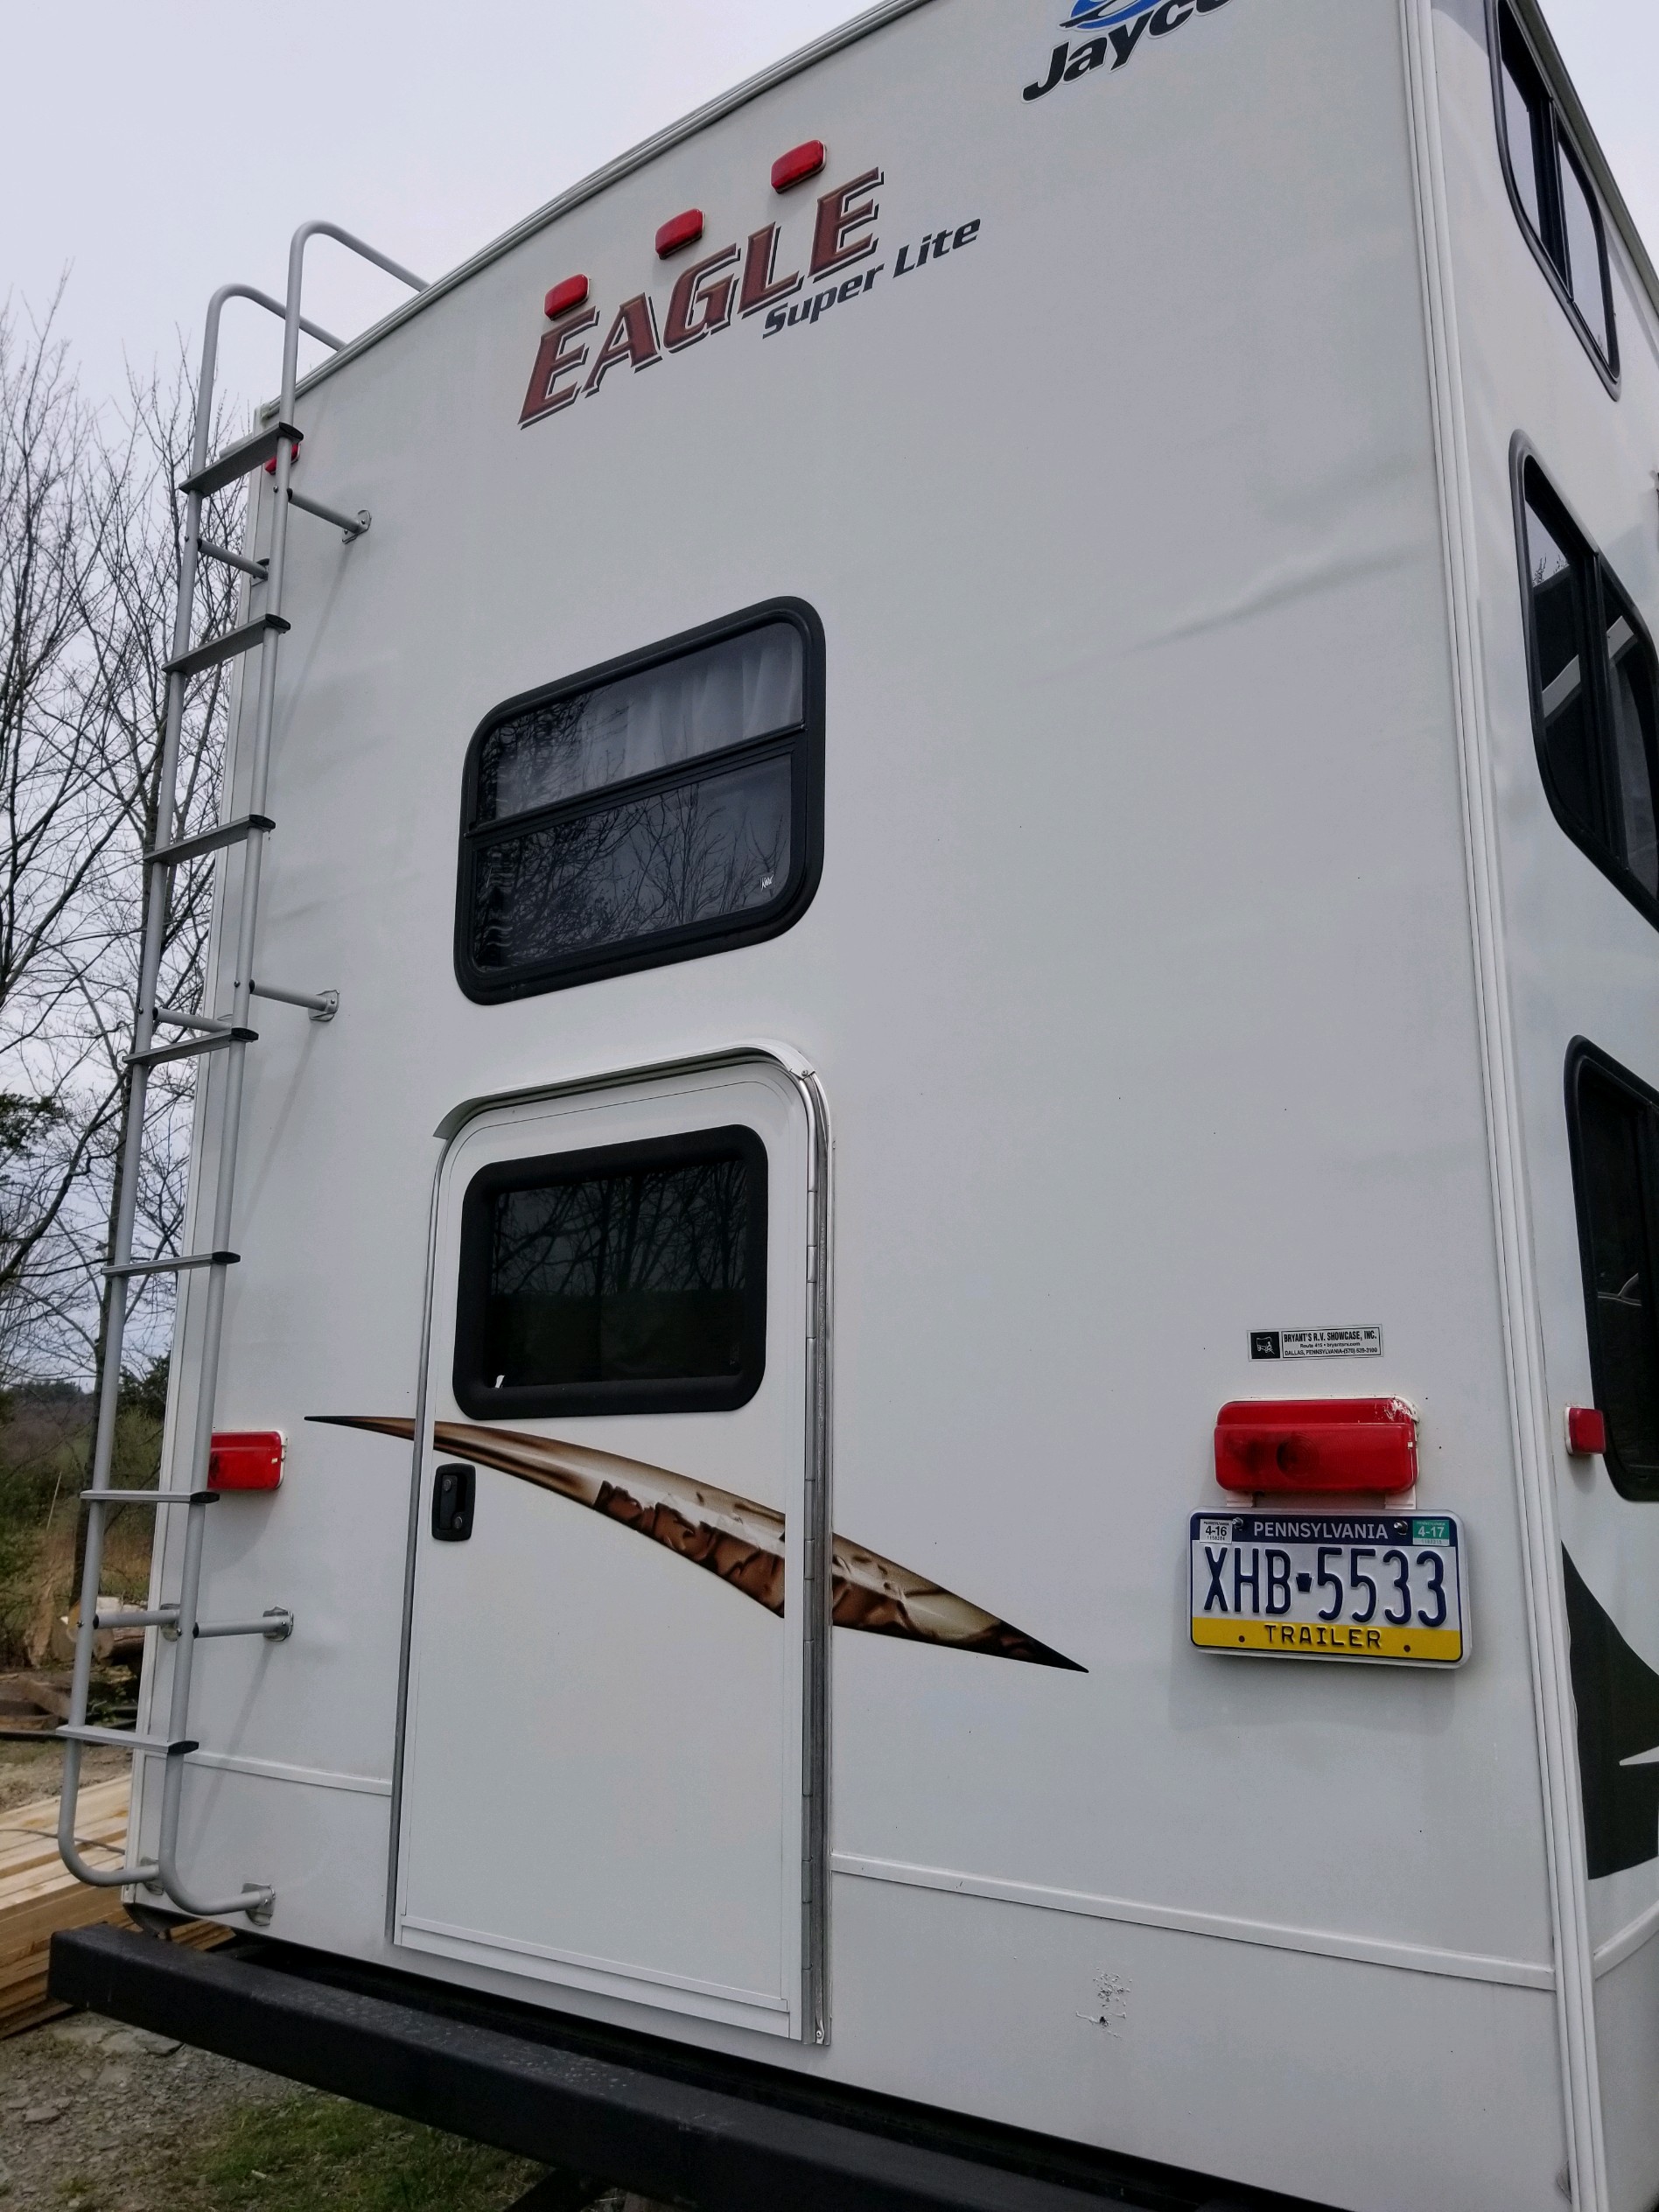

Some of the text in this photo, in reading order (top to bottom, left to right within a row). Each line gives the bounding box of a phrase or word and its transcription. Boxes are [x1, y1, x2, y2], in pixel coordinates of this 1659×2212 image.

[762, 218, 981, 340] Super Lite
[517, 166, 885, 430] EAGLE
[1284, 1330, 1377, 1342] BRYANT'S R.V. SHOWCASE, INC.
[1205, 1525, 1228, 1536] 4-16
[1253, 1521, 1389, 1540] PENNSYLVANIA
[1418, 1525, 1445, 1538] 4-17
[1264, 1624, 1382, 1648] TRAILER
